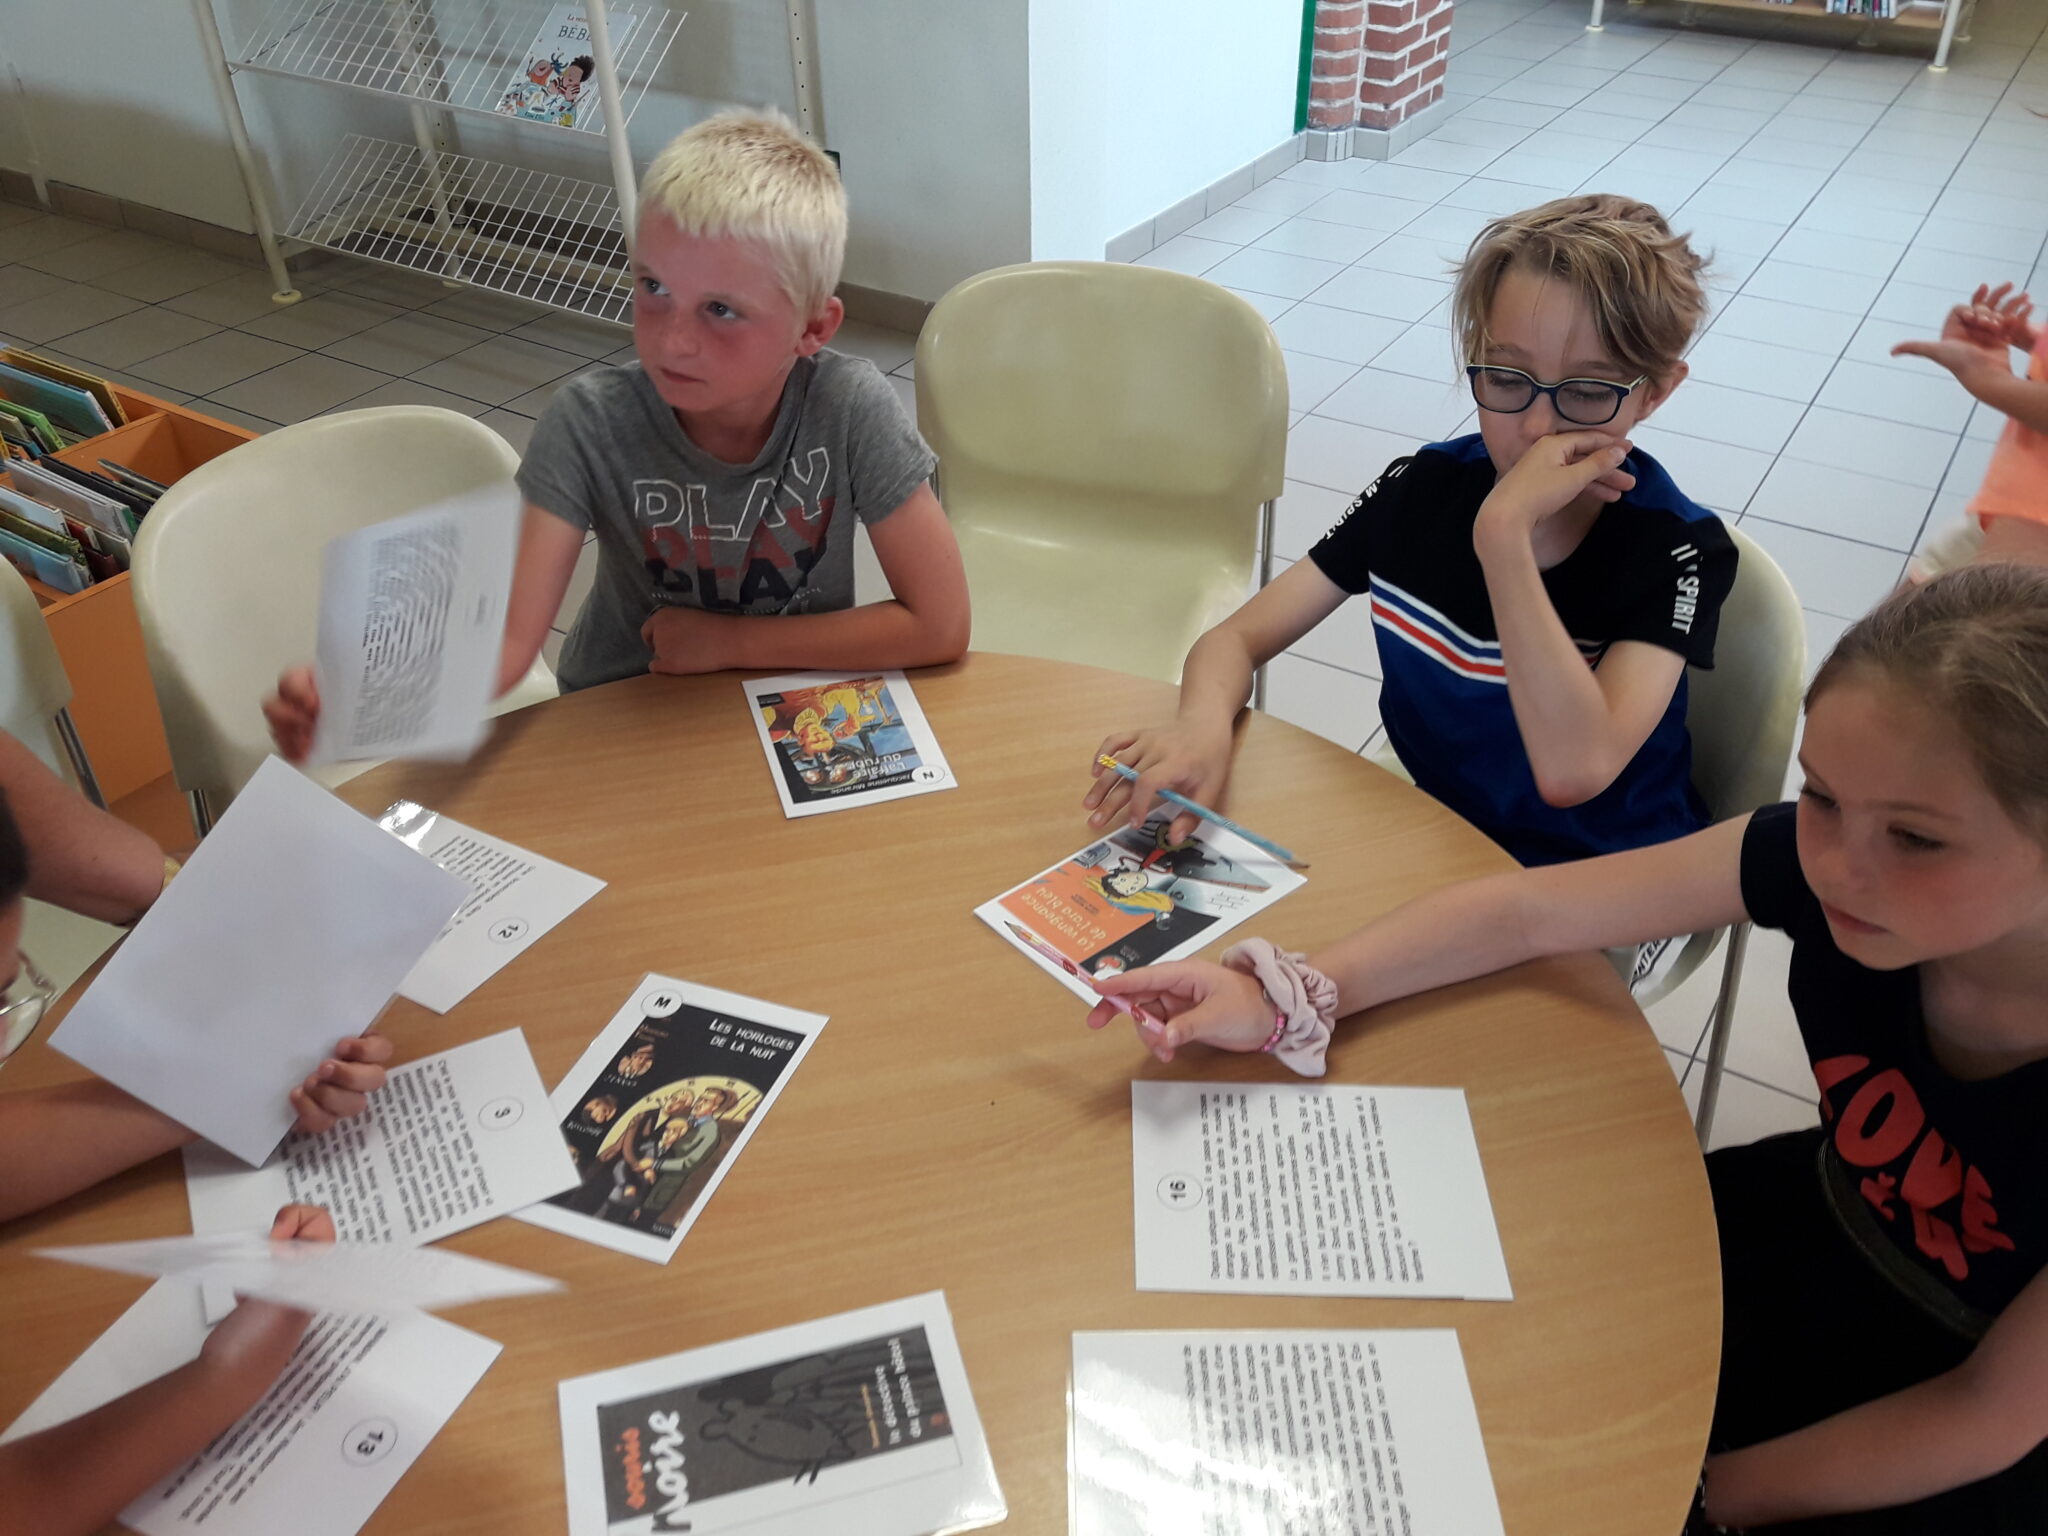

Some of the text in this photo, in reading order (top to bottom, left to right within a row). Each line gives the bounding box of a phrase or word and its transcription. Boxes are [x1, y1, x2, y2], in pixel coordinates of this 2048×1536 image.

[632, 446, 831, 543] PLAY
[1671, 575, 1700, 635] SPIRIT
[922, 770, 934, 781] N
[1035, 886, 1064, 909] bleu
[1021, 892, 1078, 938] vengeance
[497, 924, 519, 939] 12
[1090, 926, 1107, 941] de
[1077, 936, 1096, 952] La
[653, 995, 672, 1010] M
[709, 1034, 777, 1061] DE LA NUIT
[735, 1026, 796, 1051] HORLOGES
[1813, 1053, 2016, 1254] LOVE
[1169, 1180, 1187, 1202] 16
